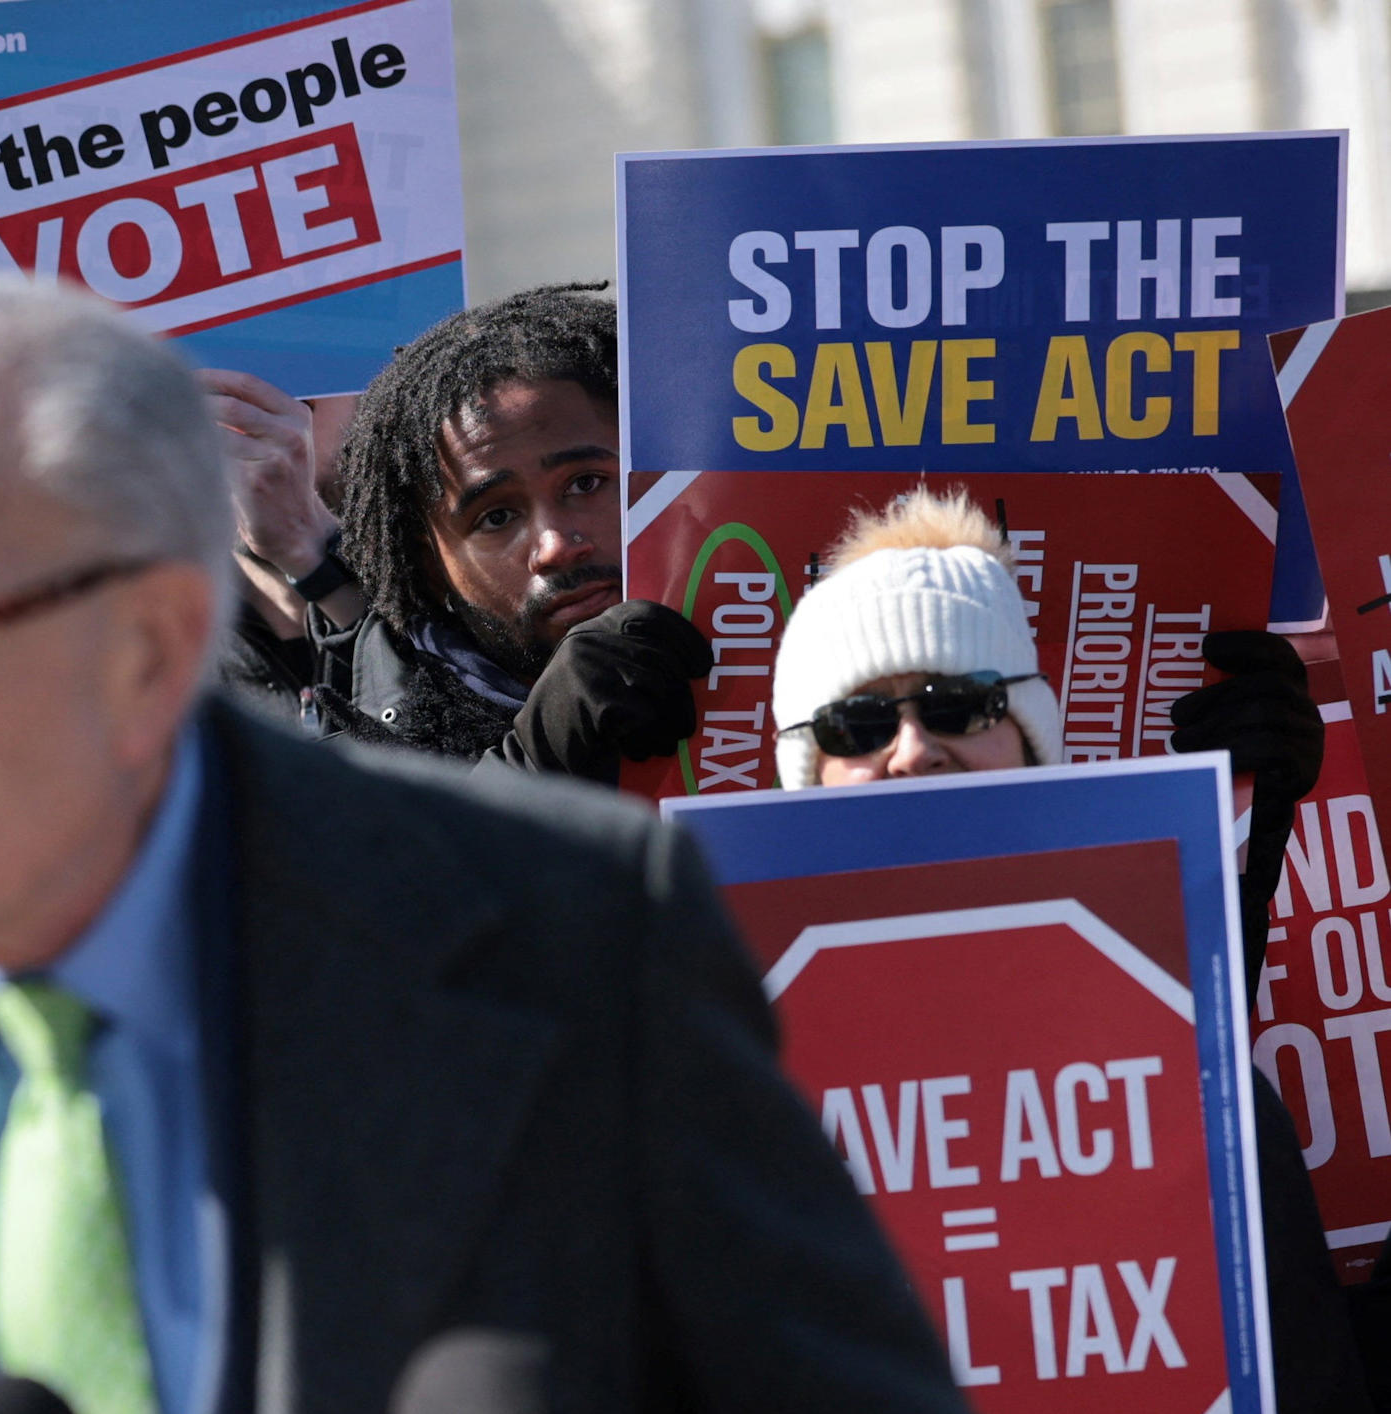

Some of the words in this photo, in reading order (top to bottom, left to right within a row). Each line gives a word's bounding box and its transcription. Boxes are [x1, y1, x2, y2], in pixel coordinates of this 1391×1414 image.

[140, 37, 407, 168] people
[727, 224, 1005, 333] STOP
[1046, 216, 1243, 323] THE
[732, 338, 996, 452] SAVE
[1030, 330, 1240, 442] ACT
[708, 572, 776, 690] POLL
[1069, 563, 1139, 764] PRIORITIE
[699, 701, 766, 790] TAX
[821, 1075, 981, 1195] AVE
[1000, 1056, 1163, 1183] ACT
[1011, 1257, 1188, 1380] TAX
